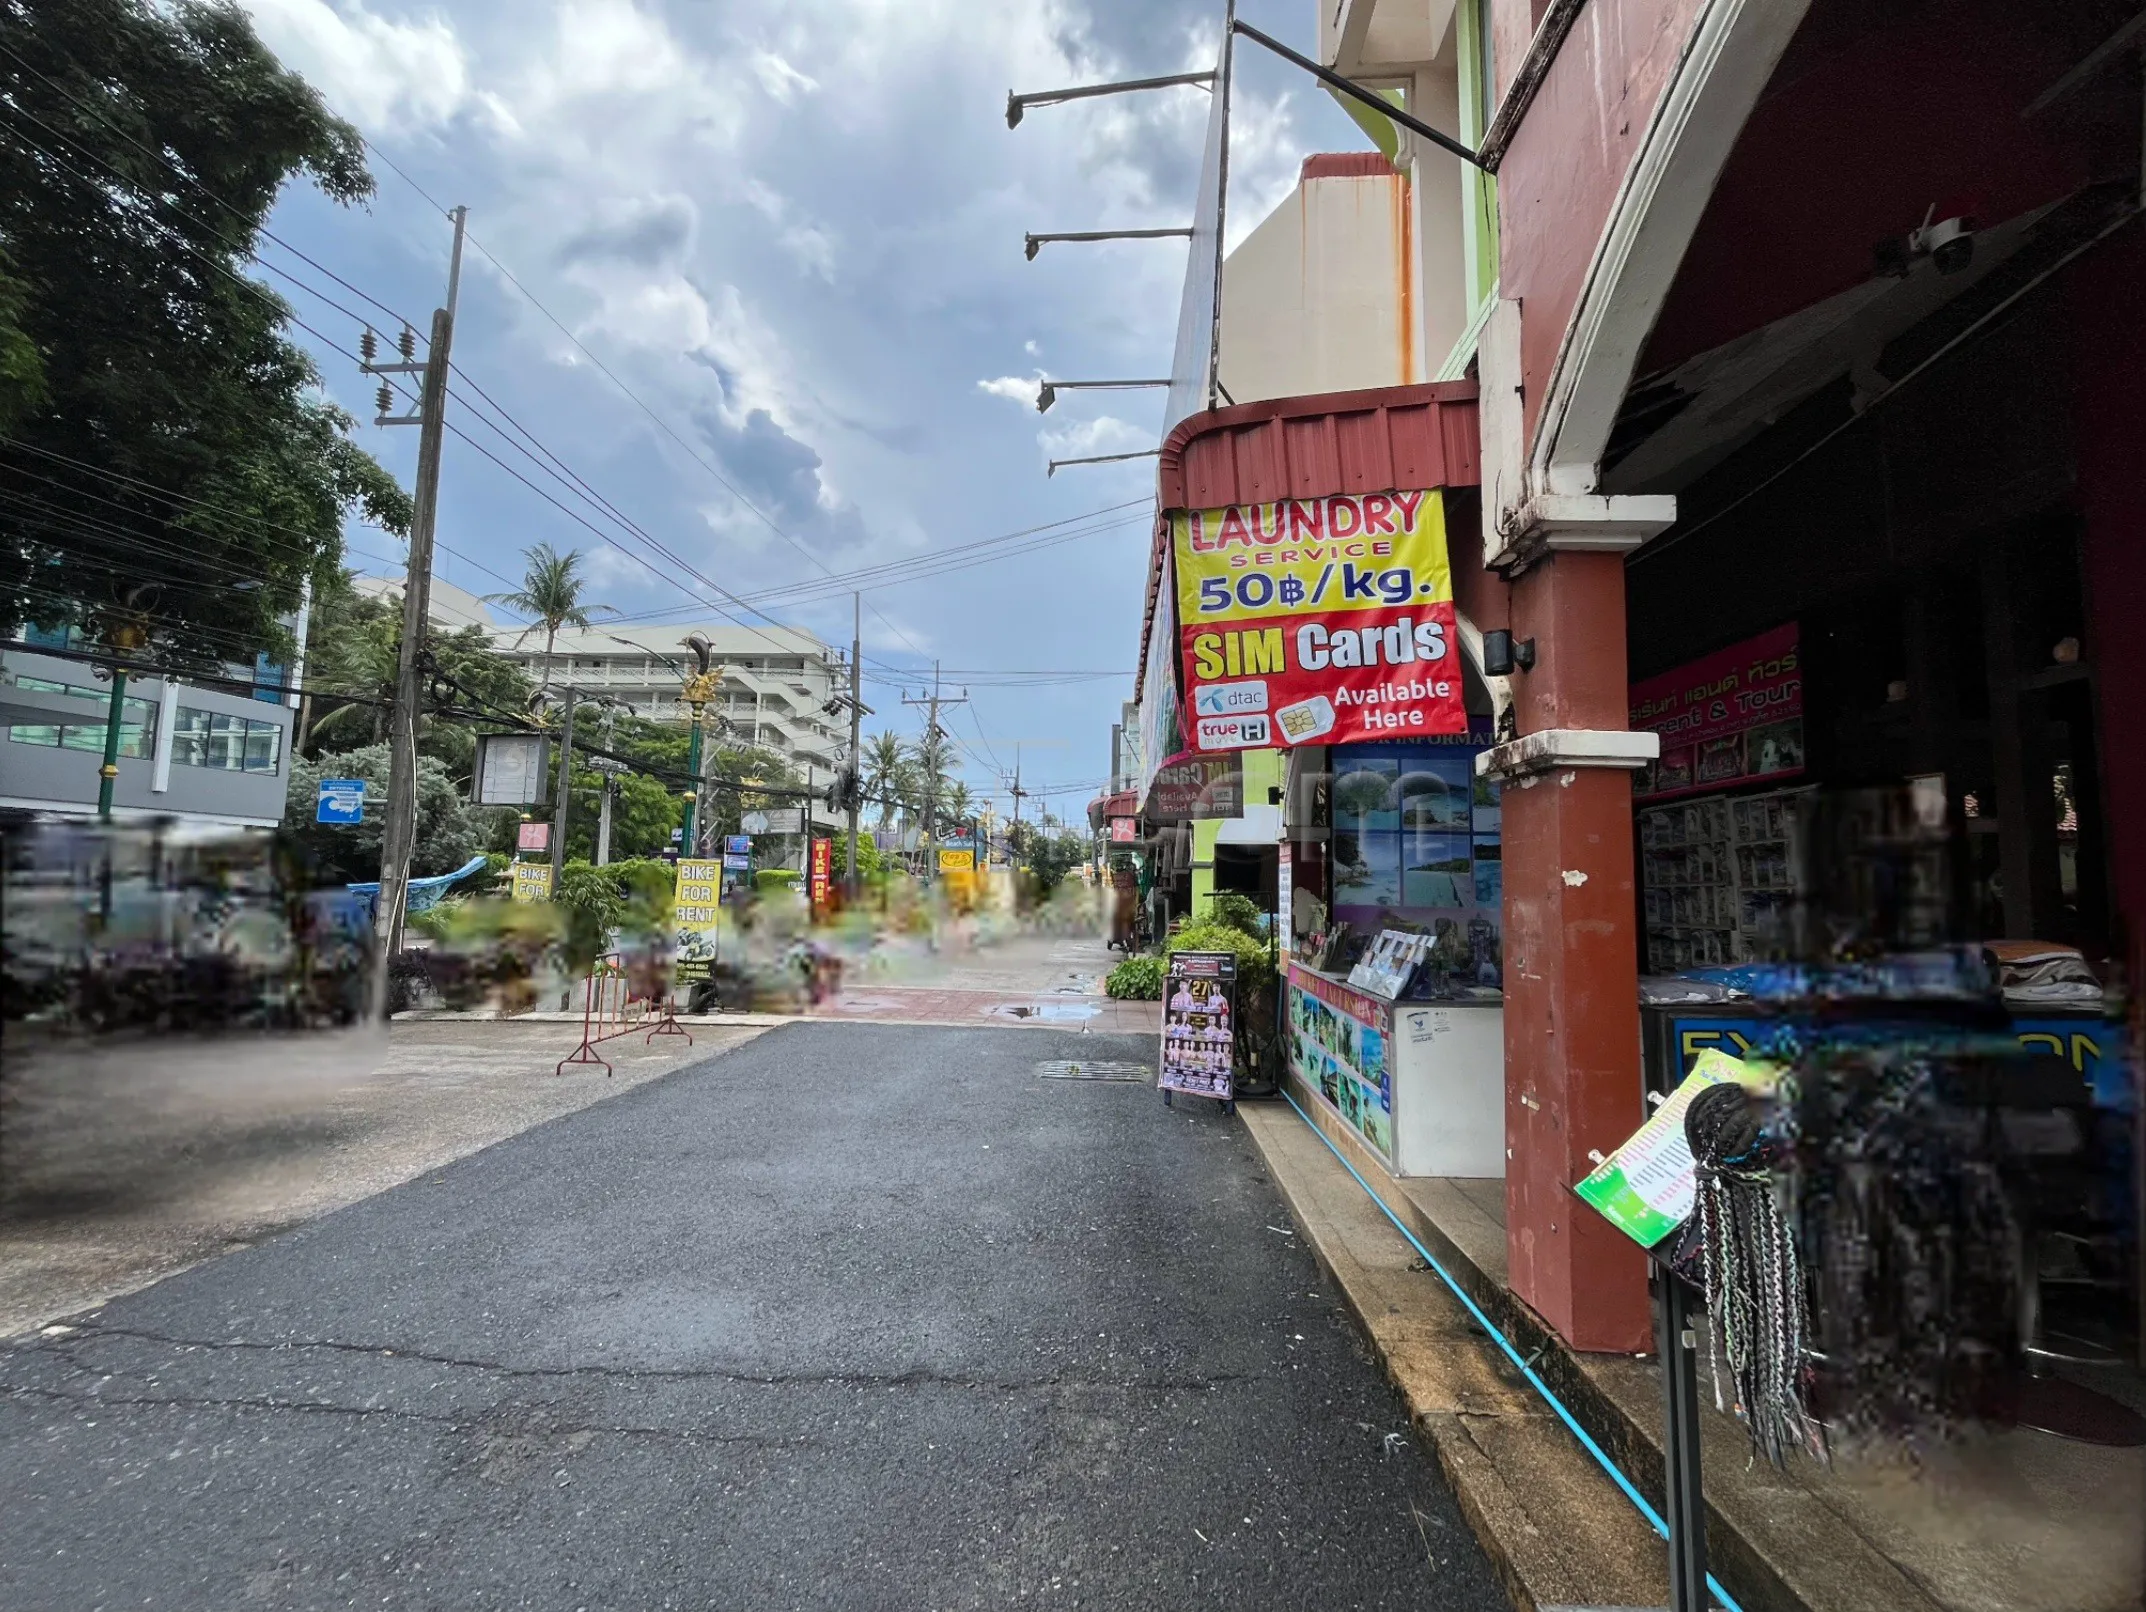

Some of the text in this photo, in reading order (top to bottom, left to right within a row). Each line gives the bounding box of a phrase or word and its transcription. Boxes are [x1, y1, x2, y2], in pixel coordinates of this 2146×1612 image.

[1191, 491, 1424, 551] LAUNDRY
[1230, 541, 1391, 567] SERVICE
[1193, 617, 1446, 680] SIM Cards
[1228, 691, 1262, 705] dtac
[1335, 678, 1449, 706] Available
[1708, 700, 1729, 722] &
[1735, 679, 1803, 713] Tour
[1363, 709, 1424, 731] Here
[1202, 722, 1238, 735] true
[519, 868, 547, 880] BIKE
[681, 866, 715, 881] BIKE
[519, 884, 543, 897] FOR
[681, 886, 711, 902] FOR
[676, 906, 715, 923] RENT
[1192, 981, 1208, 996] 27
